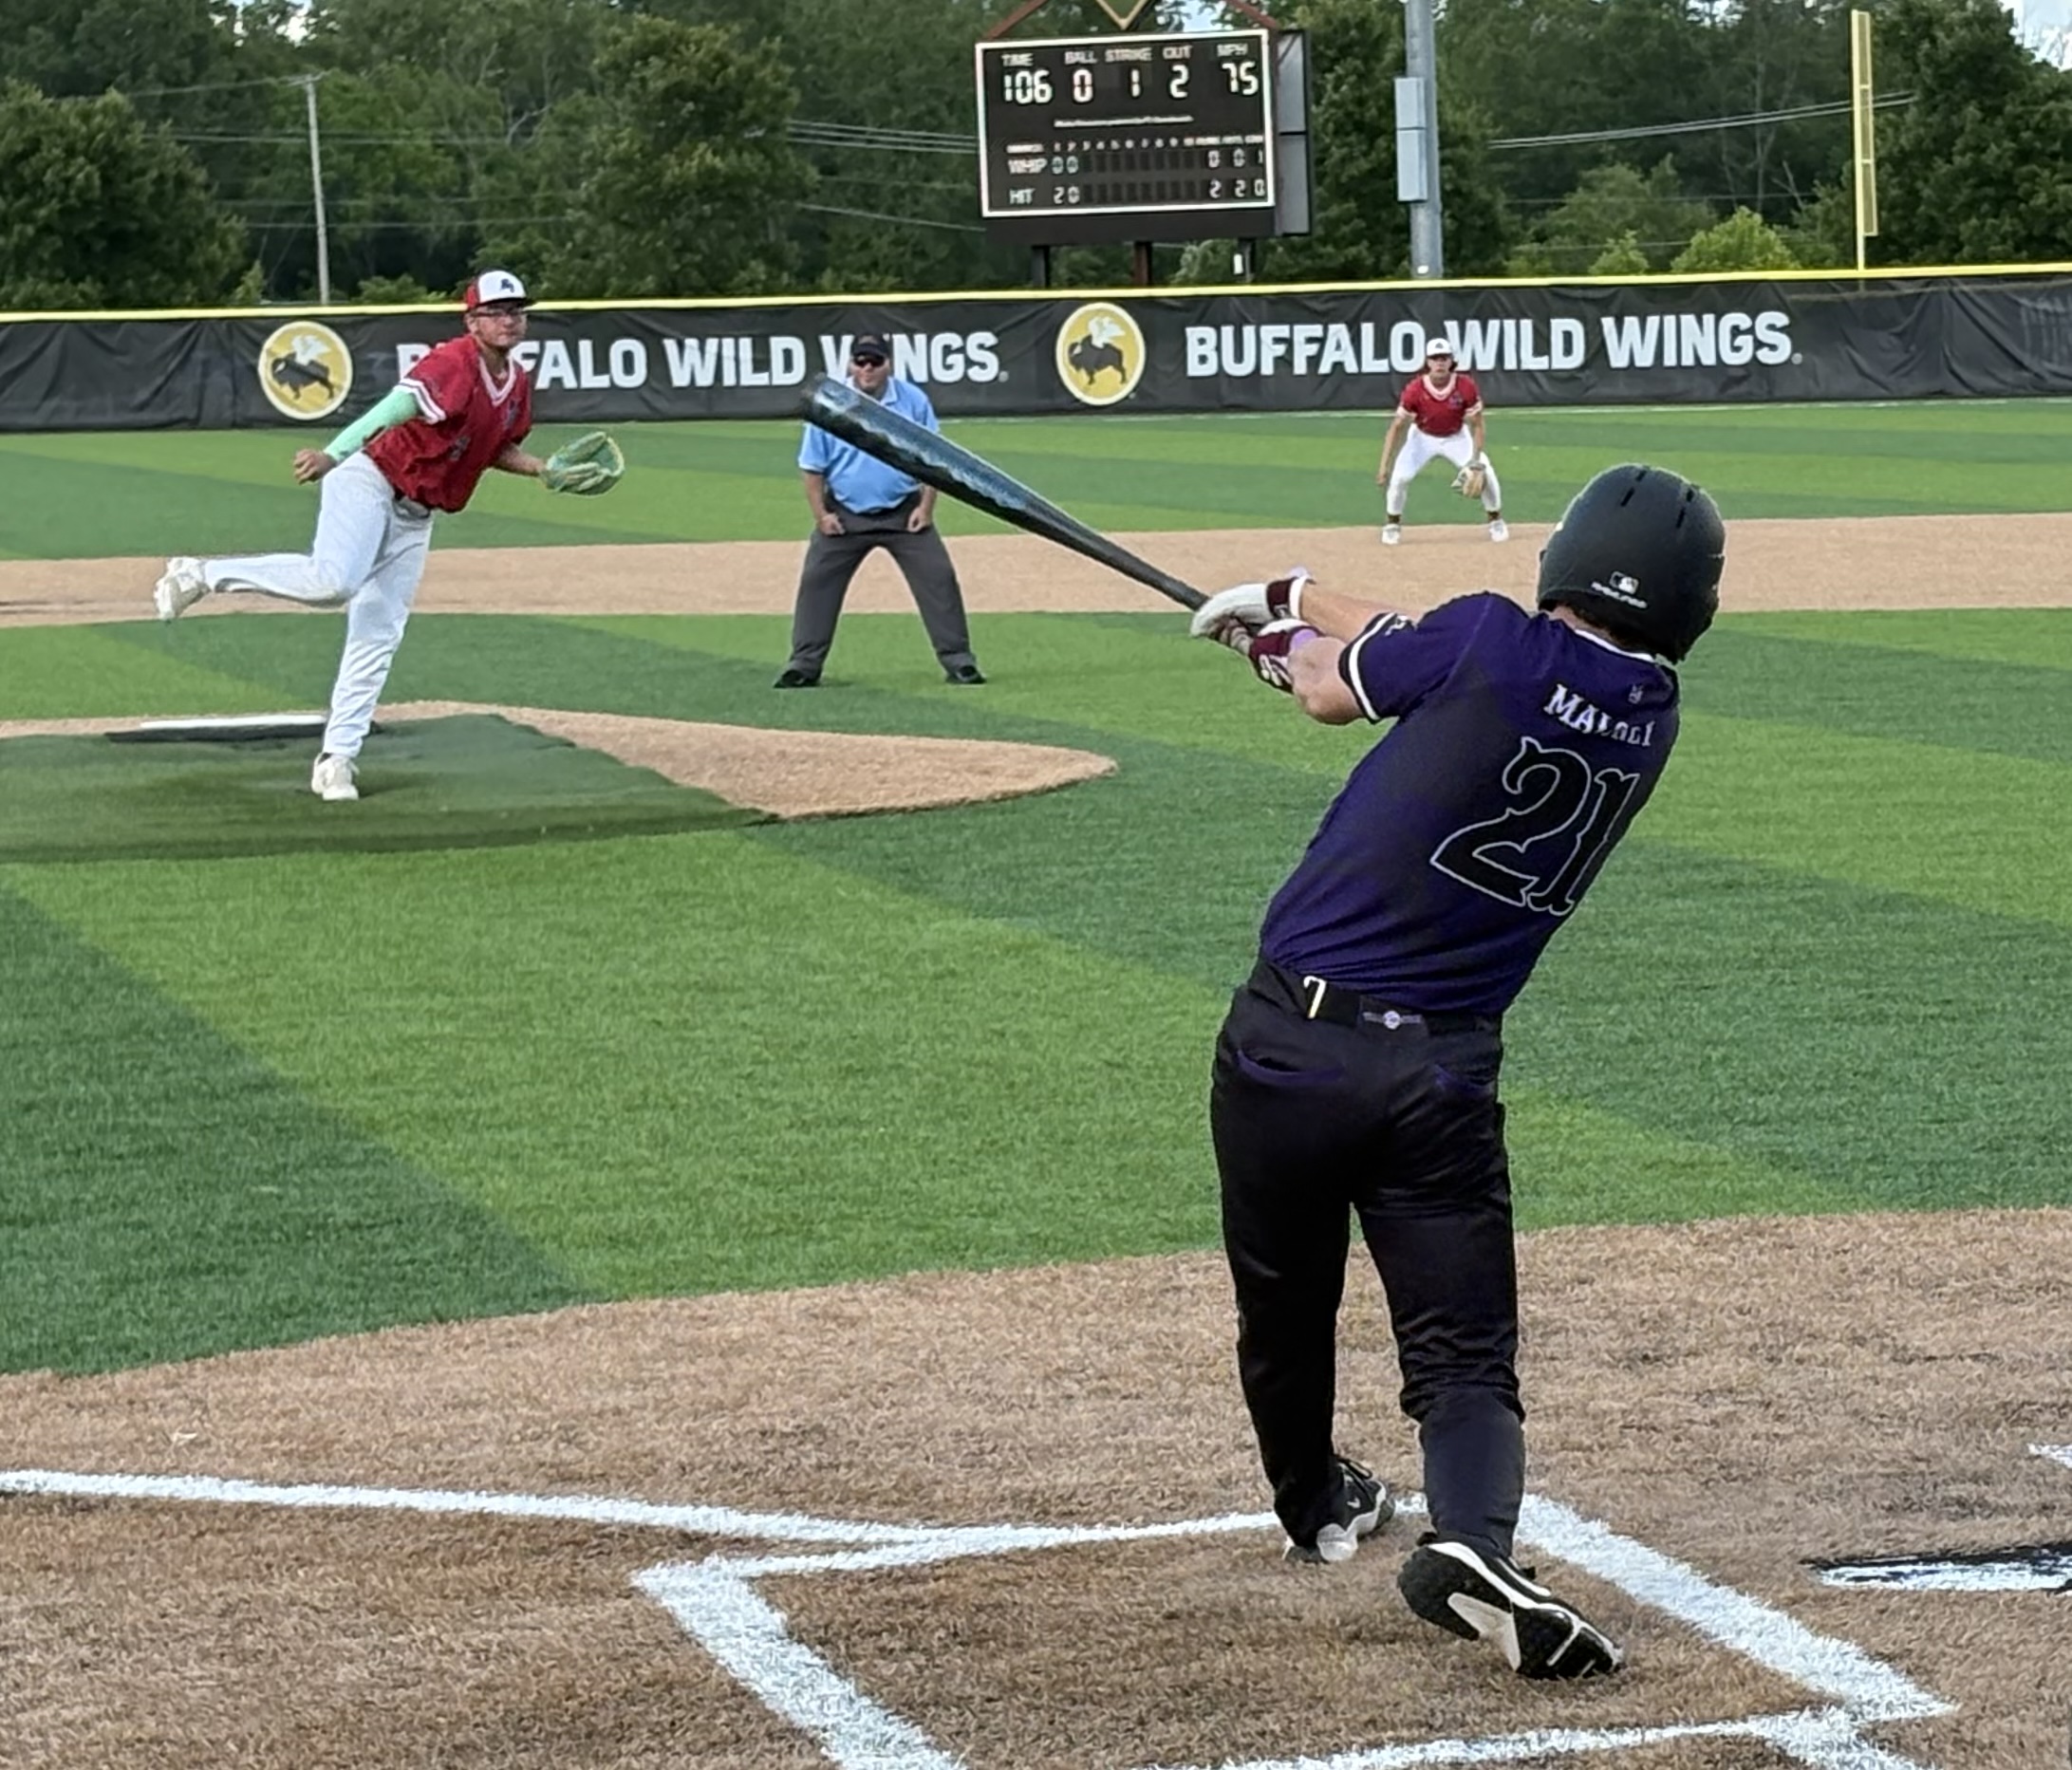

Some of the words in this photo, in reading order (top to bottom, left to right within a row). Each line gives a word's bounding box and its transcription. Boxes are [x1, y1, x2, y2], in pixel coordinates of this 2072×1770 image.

[1064, 50, 1098, 65] BALL
[1105, 47, 1152, 64] STRIKE
[1162, 45, 1193, 59] OUT
[1073, 68, 1093, 103] 0
[1131, 68, 1141, 98] 1
[1169, 64, 1189, 98] 2
[1222, 61, 1259, 96] 75
[397, 339, 648, 390] BFALO
[663, 337, 806, 388] WILD
[819, 331, 1000, 383] WNGS
[1185, 321, 1426, 378] BUFFALO
[1444, 318, 1586, 372] WILD
[1601, 310, 1793, 369] WINGS
[1429, 736, 1641, 917] 21
[1303, 976, 1328, 1019] 7
